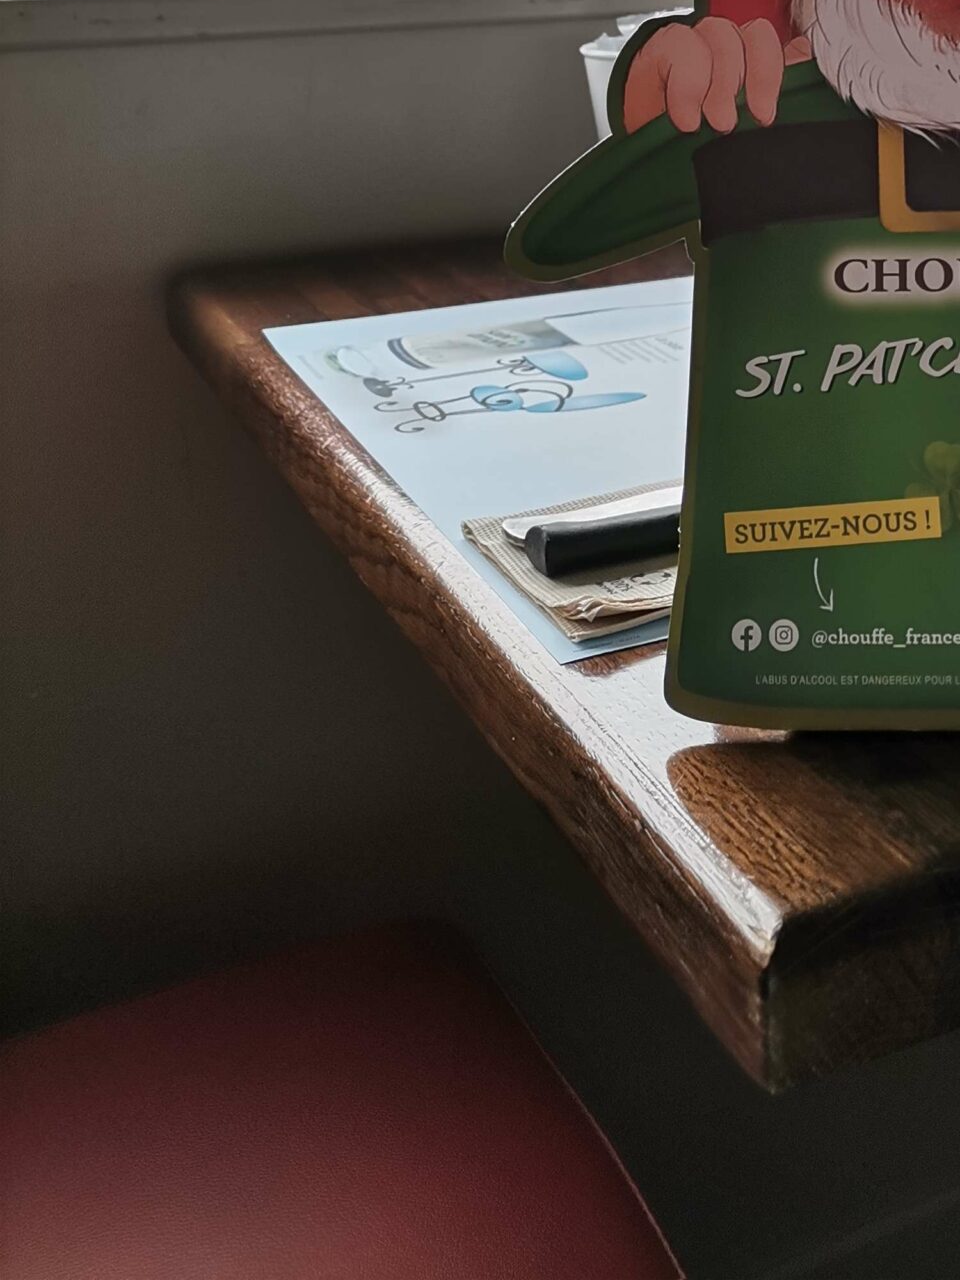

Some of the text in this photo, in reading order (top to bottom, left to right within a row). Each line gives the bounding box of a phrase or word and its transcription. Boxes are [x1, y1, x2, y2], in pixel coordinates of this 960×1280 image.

[735, 349, 805, 398] ST.
[734, 510, 918, 544] SUIVEZ-NOUS
[755, 674, 788, 686] L'ABUS
[790, 674, 838, 686] D'ALCOOL
[841, 674, 859, 686] EST
[861, 674, 921, 686] DANGEREUX
[924, 674, 951, 686] POUR
